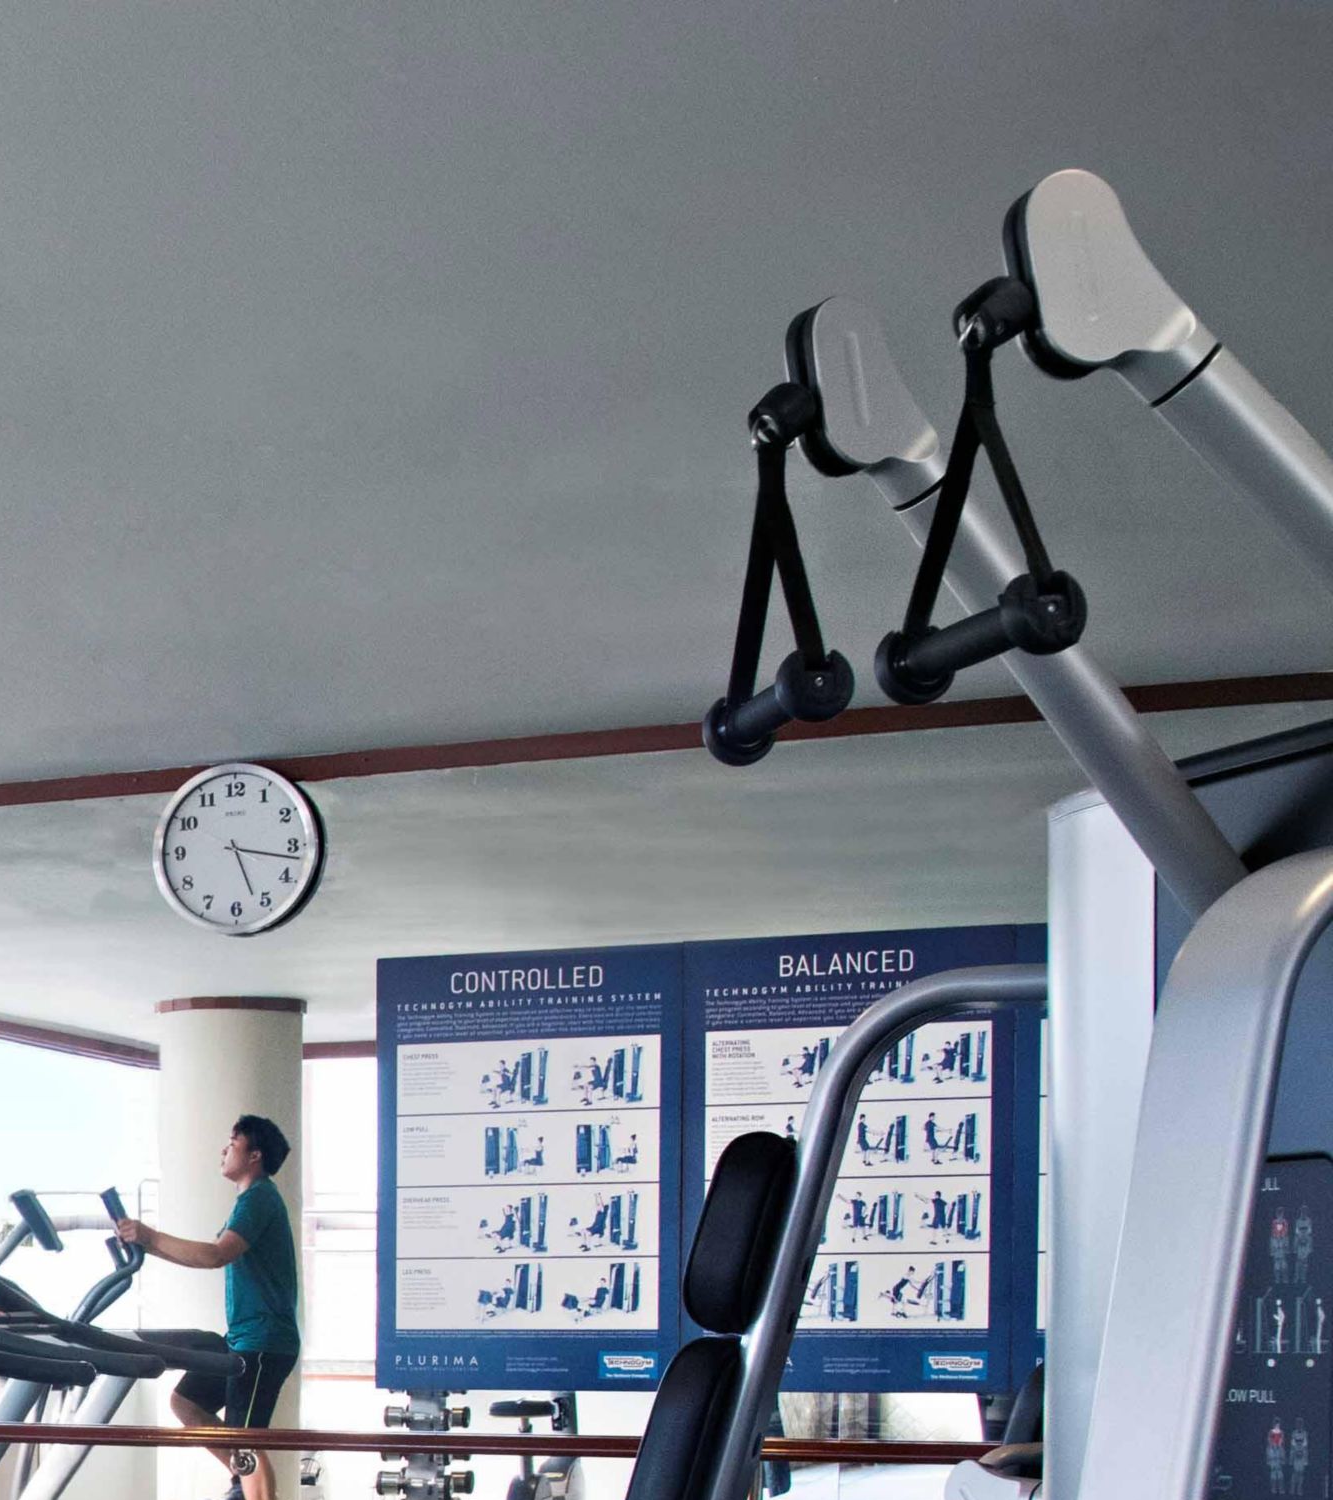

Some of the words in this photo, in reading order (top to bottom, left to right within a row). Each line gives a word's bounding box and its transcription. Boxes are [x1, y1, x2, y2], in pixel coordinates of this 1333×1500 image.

[225, 782, 245, 798] 12
[259, 789, 269, 802] 1
[199, 792, 216, 807] 11
[180, 816, 198, 830] 10
[279, 808, 291, 823] 2
[175, 846, 186, 860] 9
[287, 838, 299, 853] 3
[183, 876, 193, 890] 8
[279, 868, 293, 883] 4
[203, 895, 214, 910] 7
[260, 892, 271, 908] 5
[231, 902, 242, 916] 6
[779, 949, 914, 978] BALANCED
[451, 966, 603, 994] CONTROLLED
[706, 986, 787, 997] TECHNOGYM
[796, 982, 853, 992] ABILITY
[397, 1001, 472, 1012] TECHNOGYM
[480, 998, 532, 1008] ABILITY
[540, 995, 603, 1004] TRAINING
[611, 992, 661, 1002] SYSTEM
[395, 1355, 478, 1366] PLURIMA
[1226, 1388, 1247, 1402] OW
[1249, 1389, 1276, 1403] PULL
